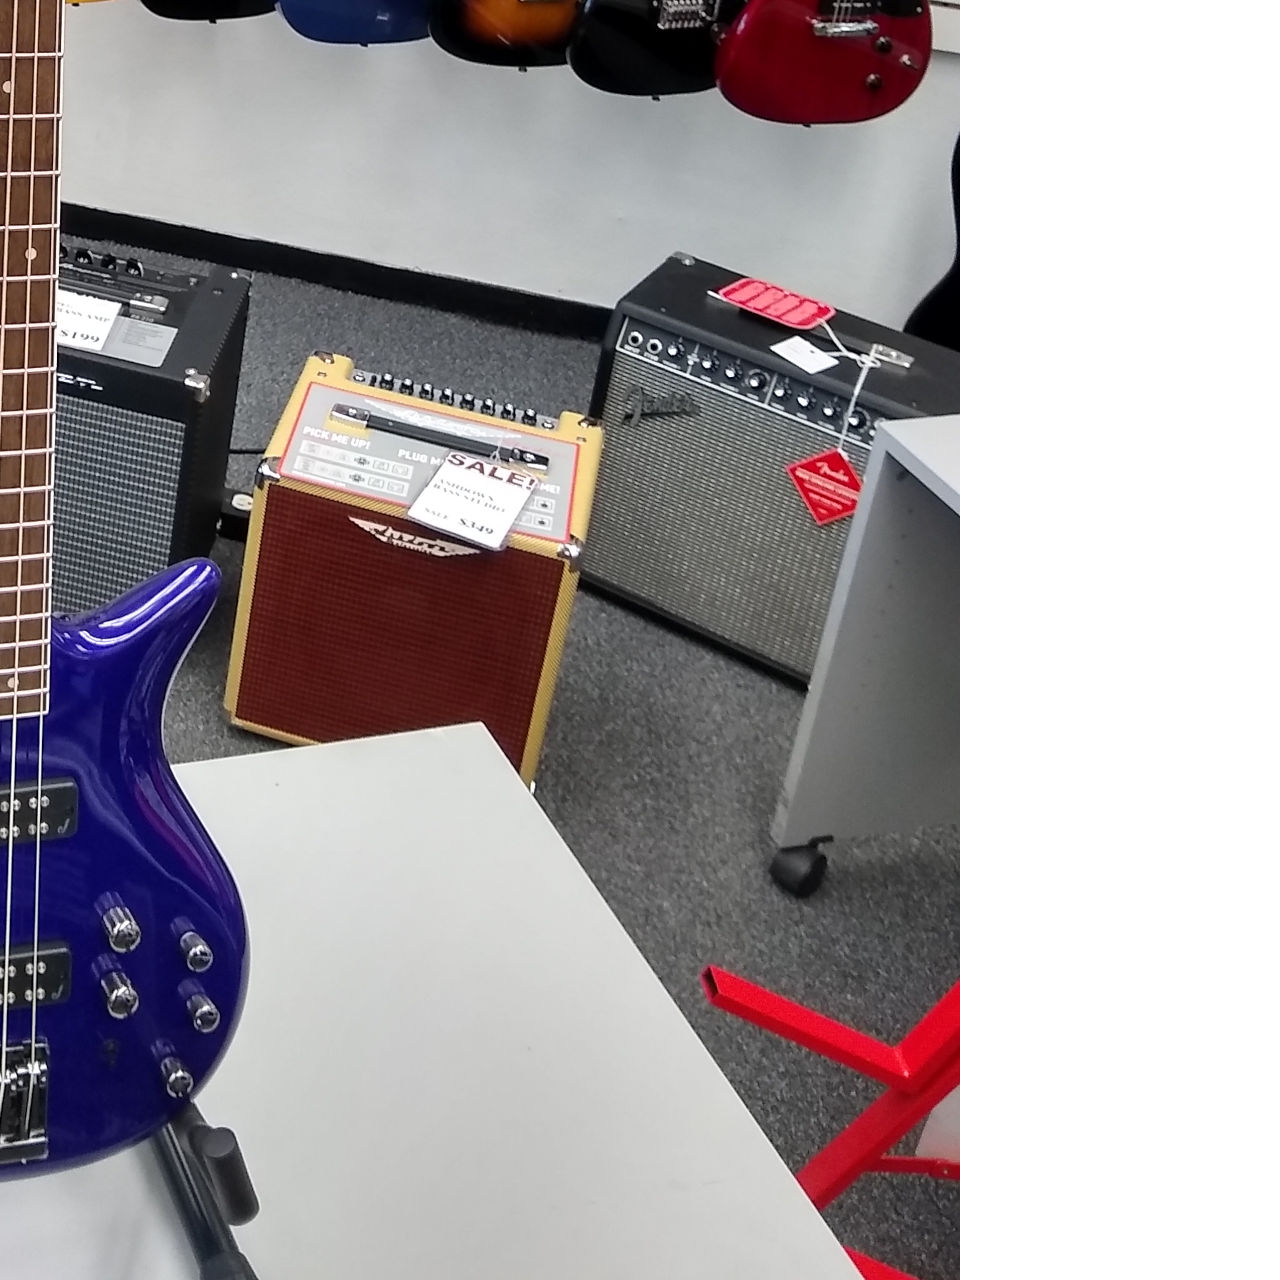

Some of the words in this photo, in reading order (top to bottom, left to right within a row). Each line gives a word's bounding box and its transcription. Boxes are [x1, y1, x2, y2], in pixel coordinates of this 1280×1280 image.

[60, 329, 100, 343] $199
[303, 426, 330, 441] PICK
[330, 433, 349, 445] ME
[350, 437, 371, 450] UP!
[398, 449, 428, 464] PLUG
[448, 453, 536, 491] SALE!
[459, 518, 494, 535] $349
